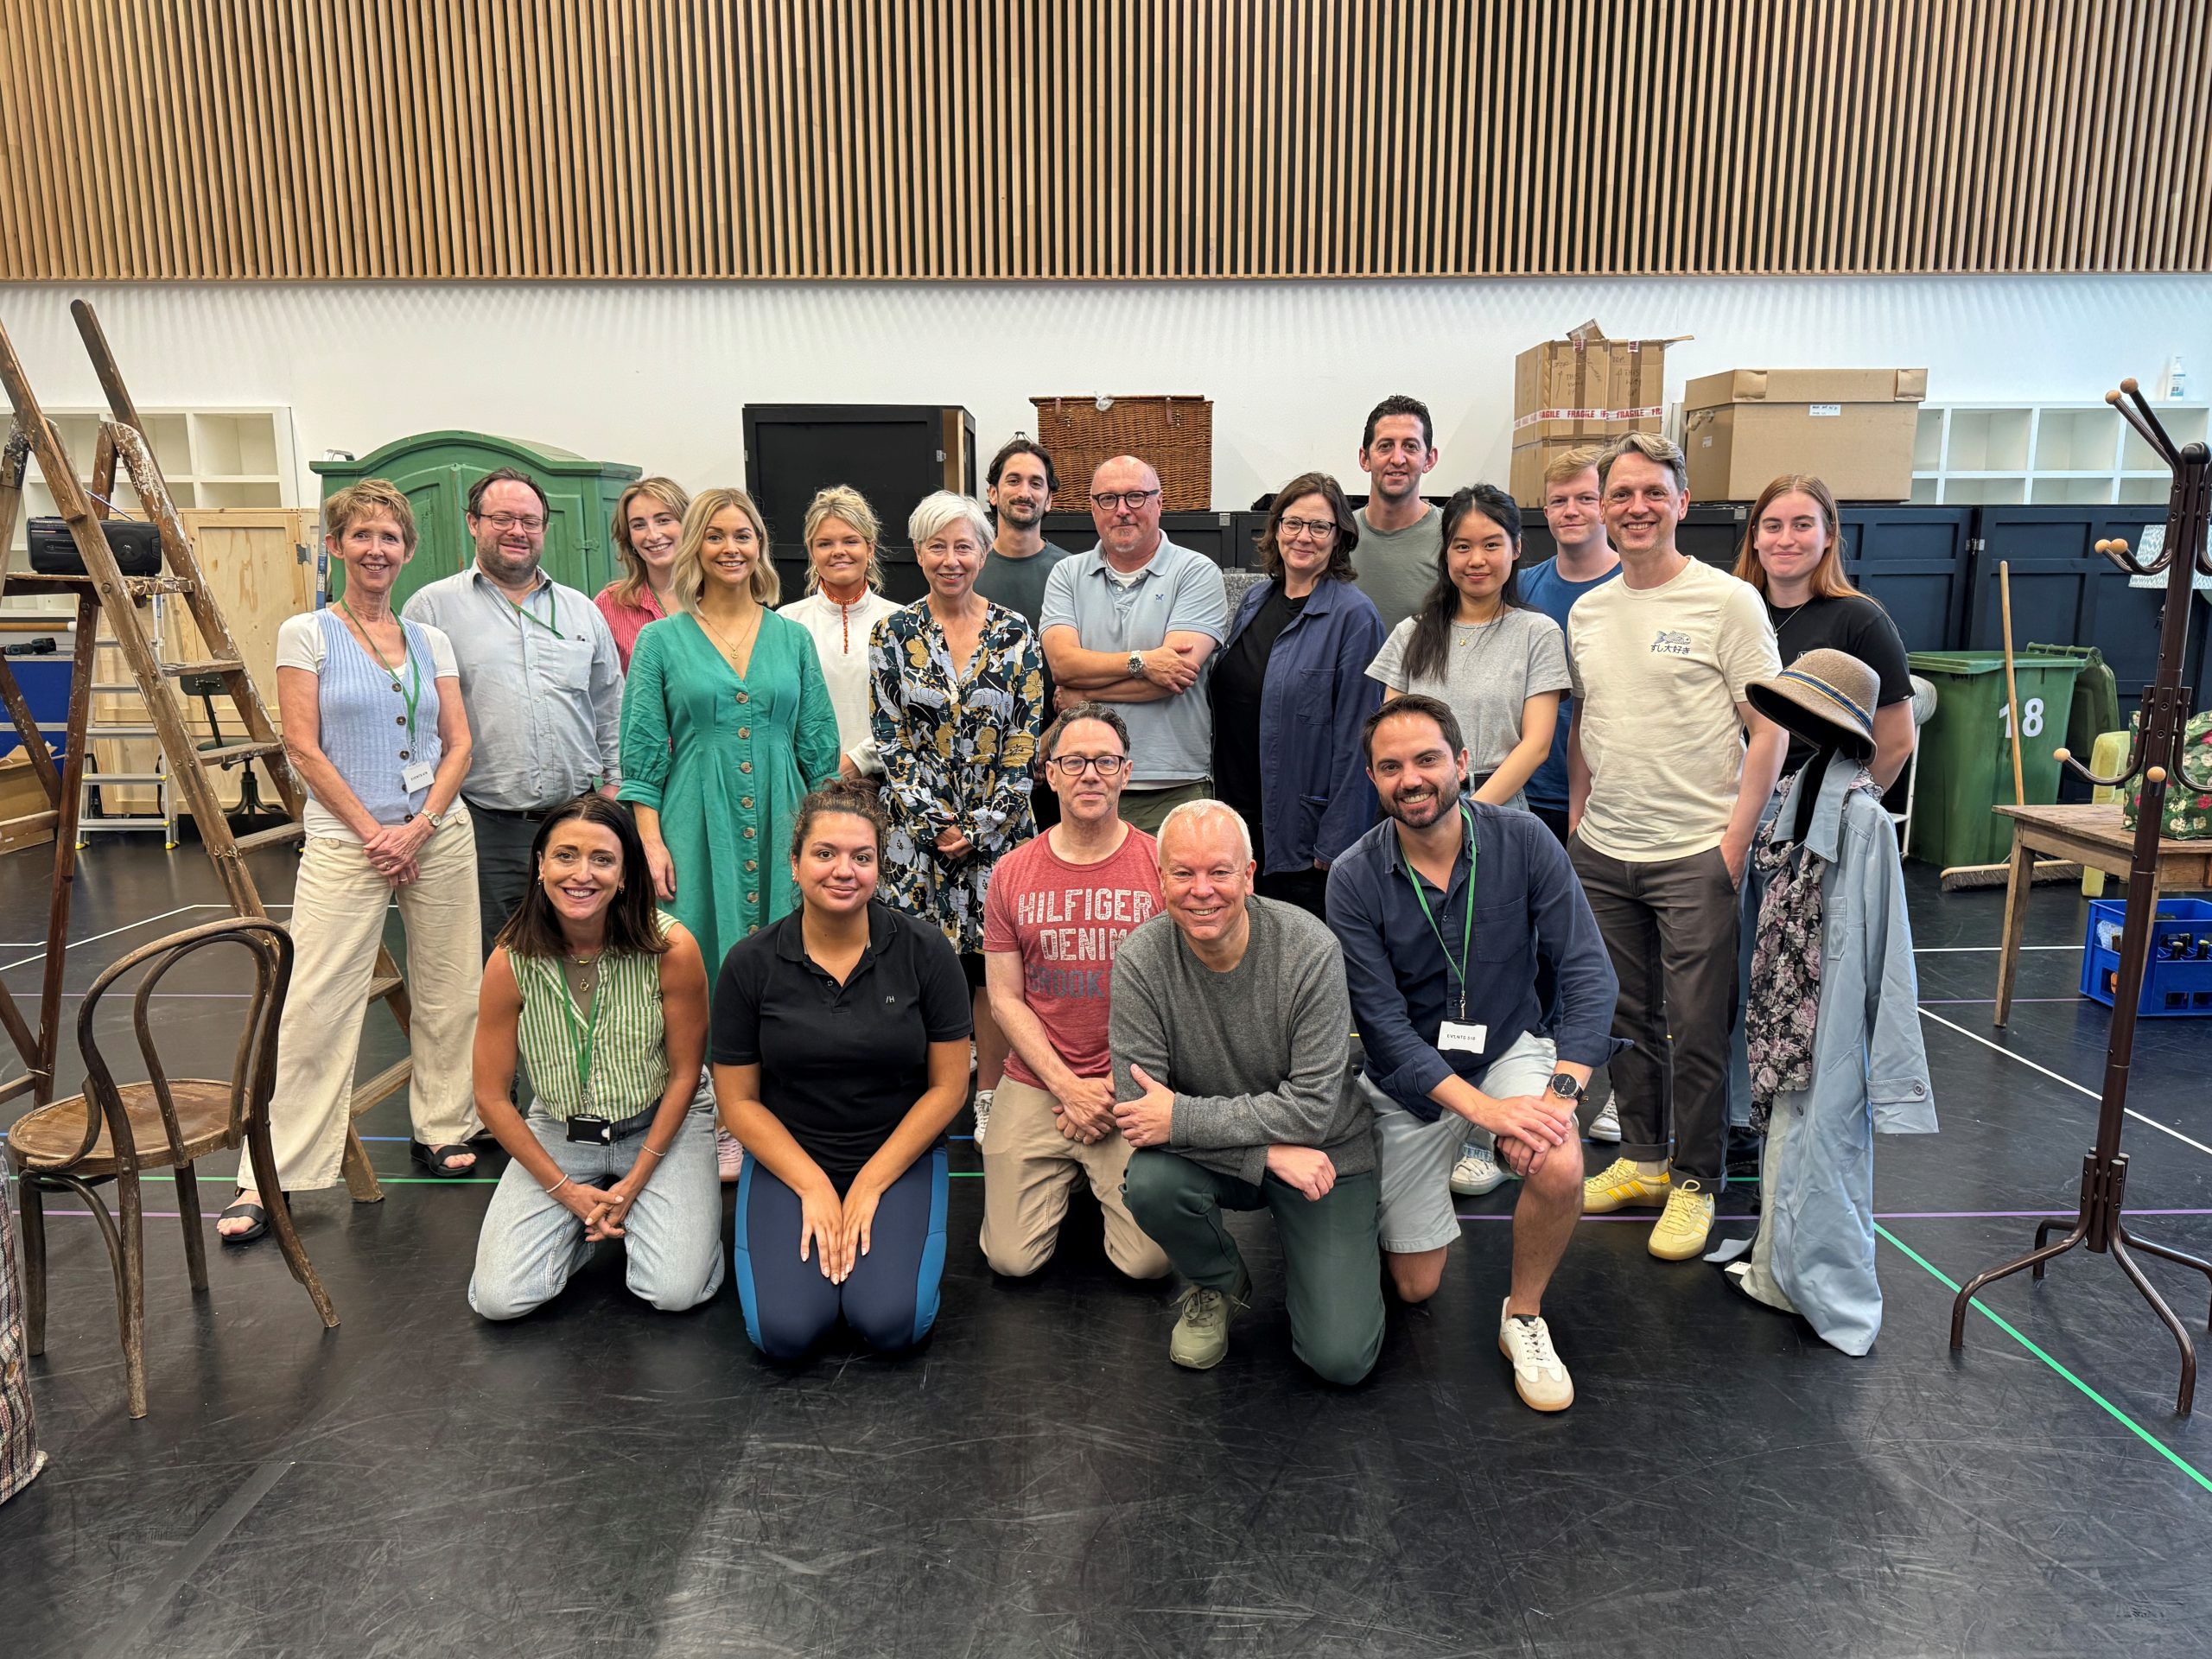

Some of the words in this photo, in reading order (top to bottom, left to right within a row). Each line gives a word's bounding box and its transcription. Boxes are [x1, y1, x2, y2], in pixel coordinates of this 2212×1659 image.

[1567, 410, 1595, 418] FRAGILE
[1616, 409, 1644, 419] FRAGILE
[1650, 644, 1691, 655] すし大好き
[1999, 697, 2044, 739] 18
[1018, 888, 1153, 926] HILFIGER
[1039, 927, 1128, 961] DENIM
